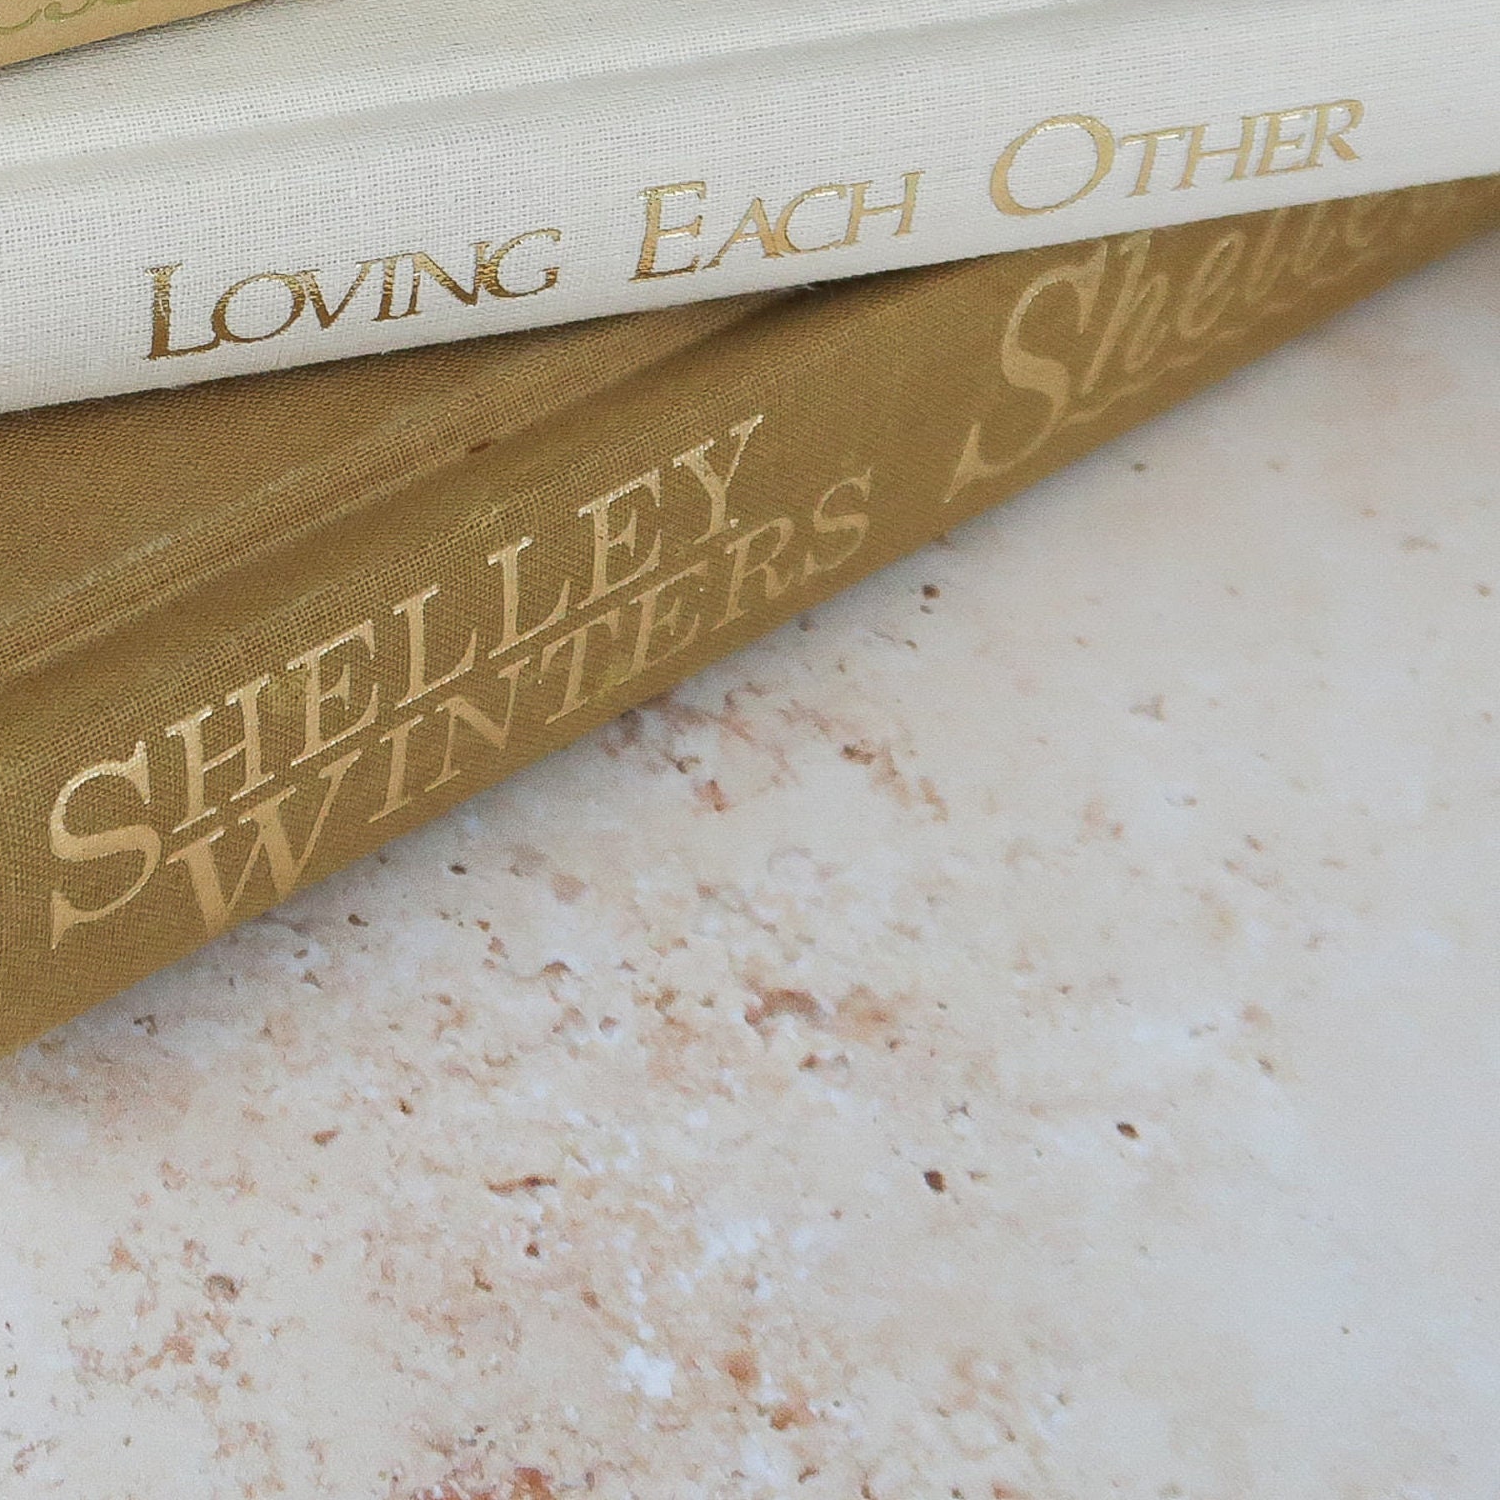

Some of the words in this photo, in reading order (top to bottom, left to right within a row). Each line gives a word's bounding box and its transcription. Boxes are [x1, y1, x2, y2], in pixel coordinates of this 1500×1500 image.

[143, 228, 563, 361] LOVING
[627, 170, 926, 282] EACH
[989, 98, 1366, 217] OTHER
[48, 413, 766, 952] SHELLEY
[166, 464, 876, 938] WINTERS
